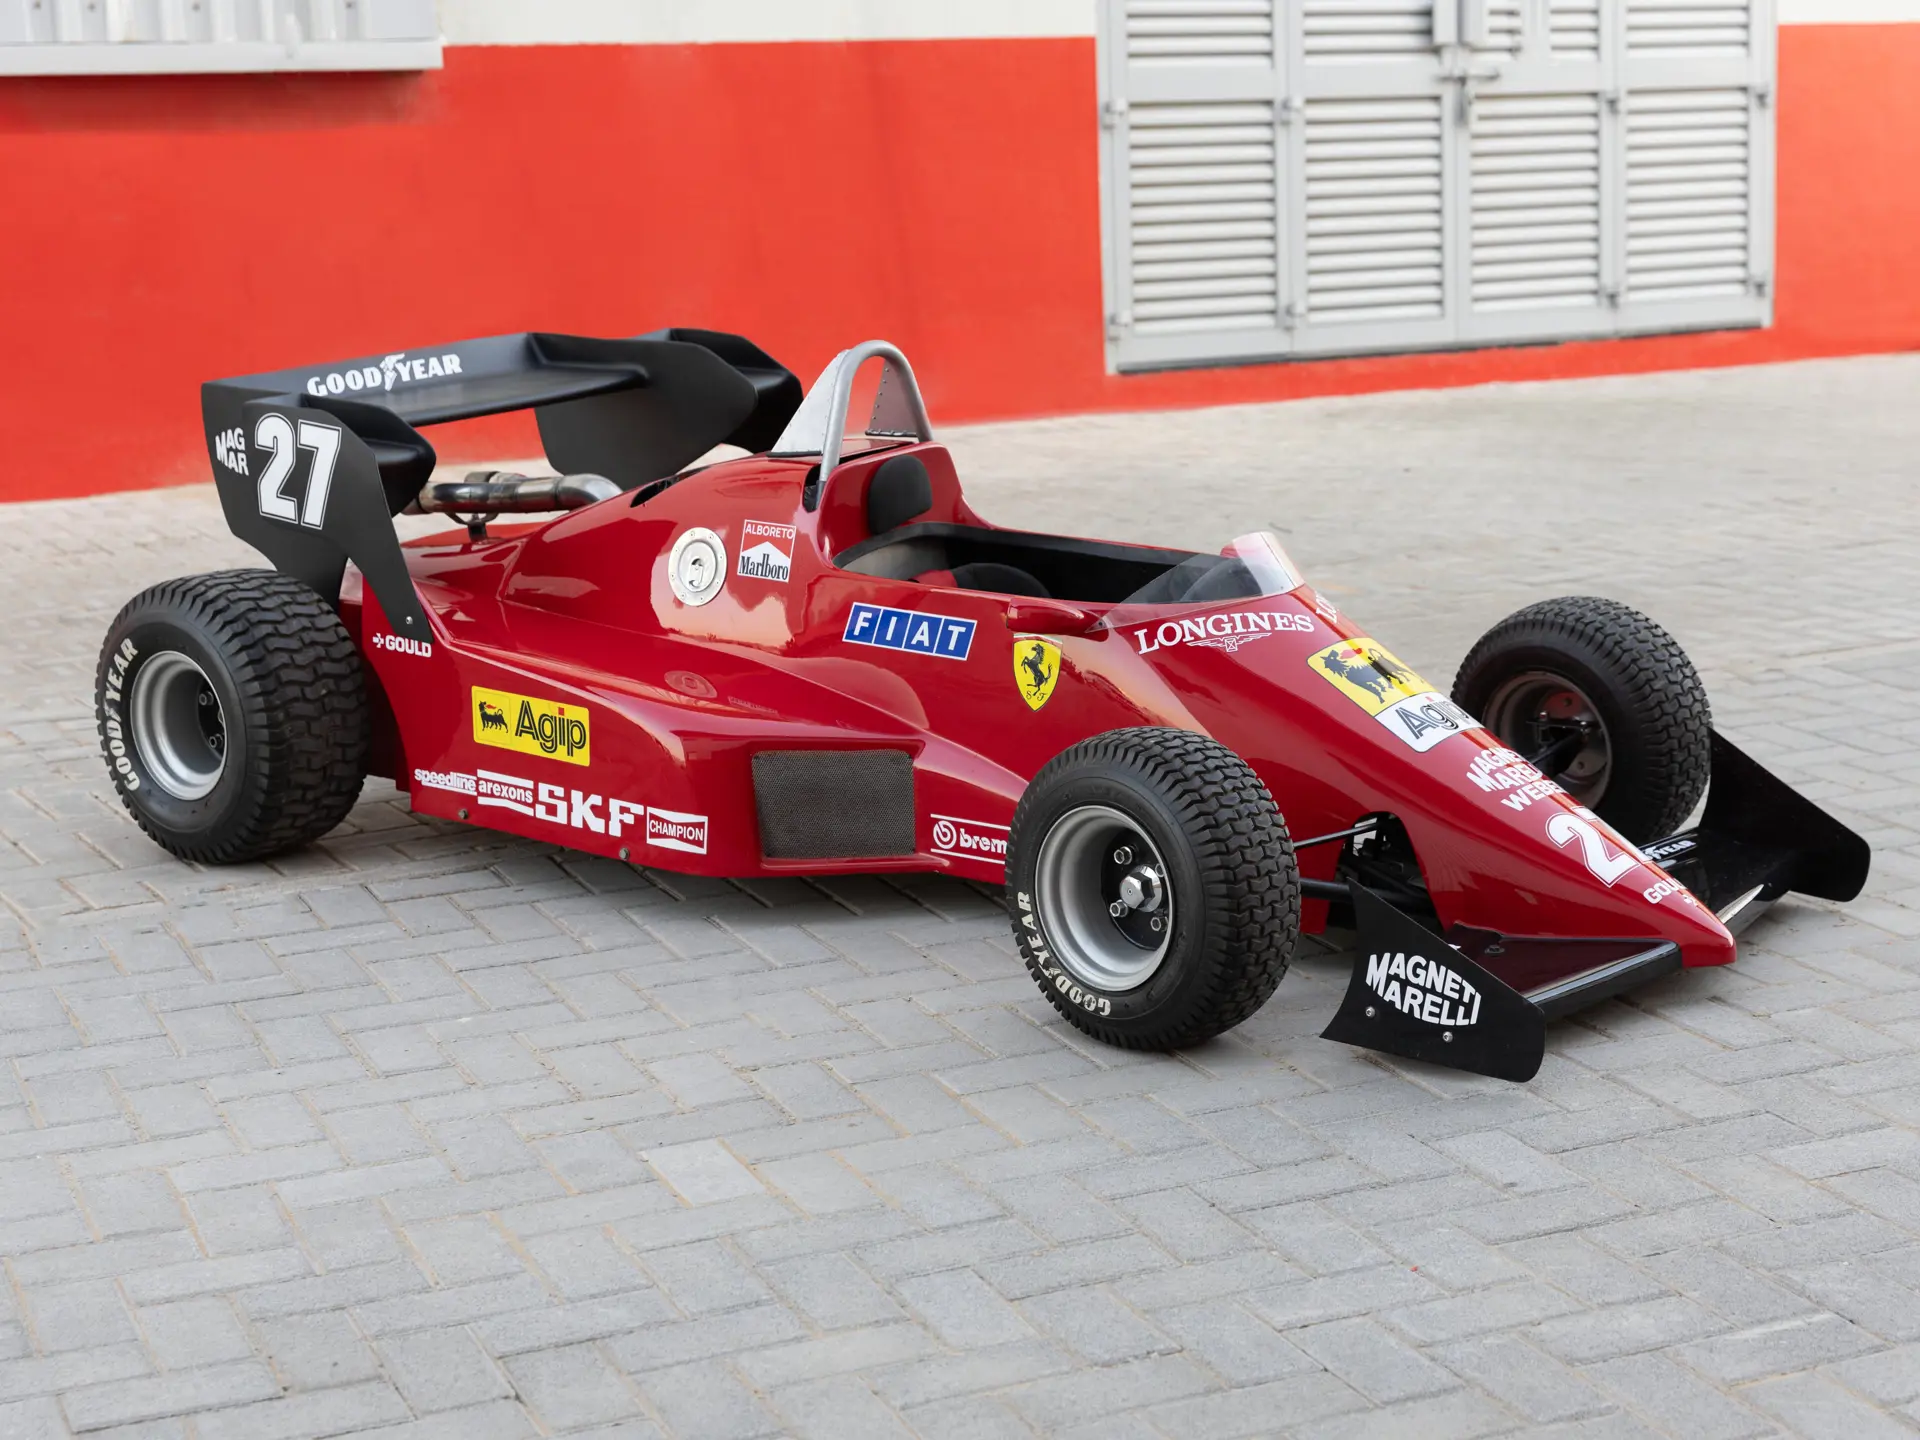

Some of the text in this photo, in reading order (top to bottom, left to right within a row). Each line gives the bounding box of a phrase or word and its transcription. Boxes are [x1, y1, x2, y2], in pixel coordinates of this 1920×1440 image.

[255, 412, 342, 530] 27
[745, 523, 794, 540] ALBORETO
[738, 553, 789, 581] Marlboro
[385, 634, 433, 658] GOULD
[852, 611, 967, 652] FIAT
[1133, 611, 1315, 655] LONGINES
[515, 700, 587, 757] Agip
[414, 768, 476, 792] speedline
[478, 779, 533, 803] arexons
[535, 783, 645, 837] SKF
[649, 820, 704, 842] CHAMPION
[959, 828, 1007, 854] brem
[1365, 952, 1481, 1011] MAGNETI
[1365, 971, 1481, 1026] MARELLI
